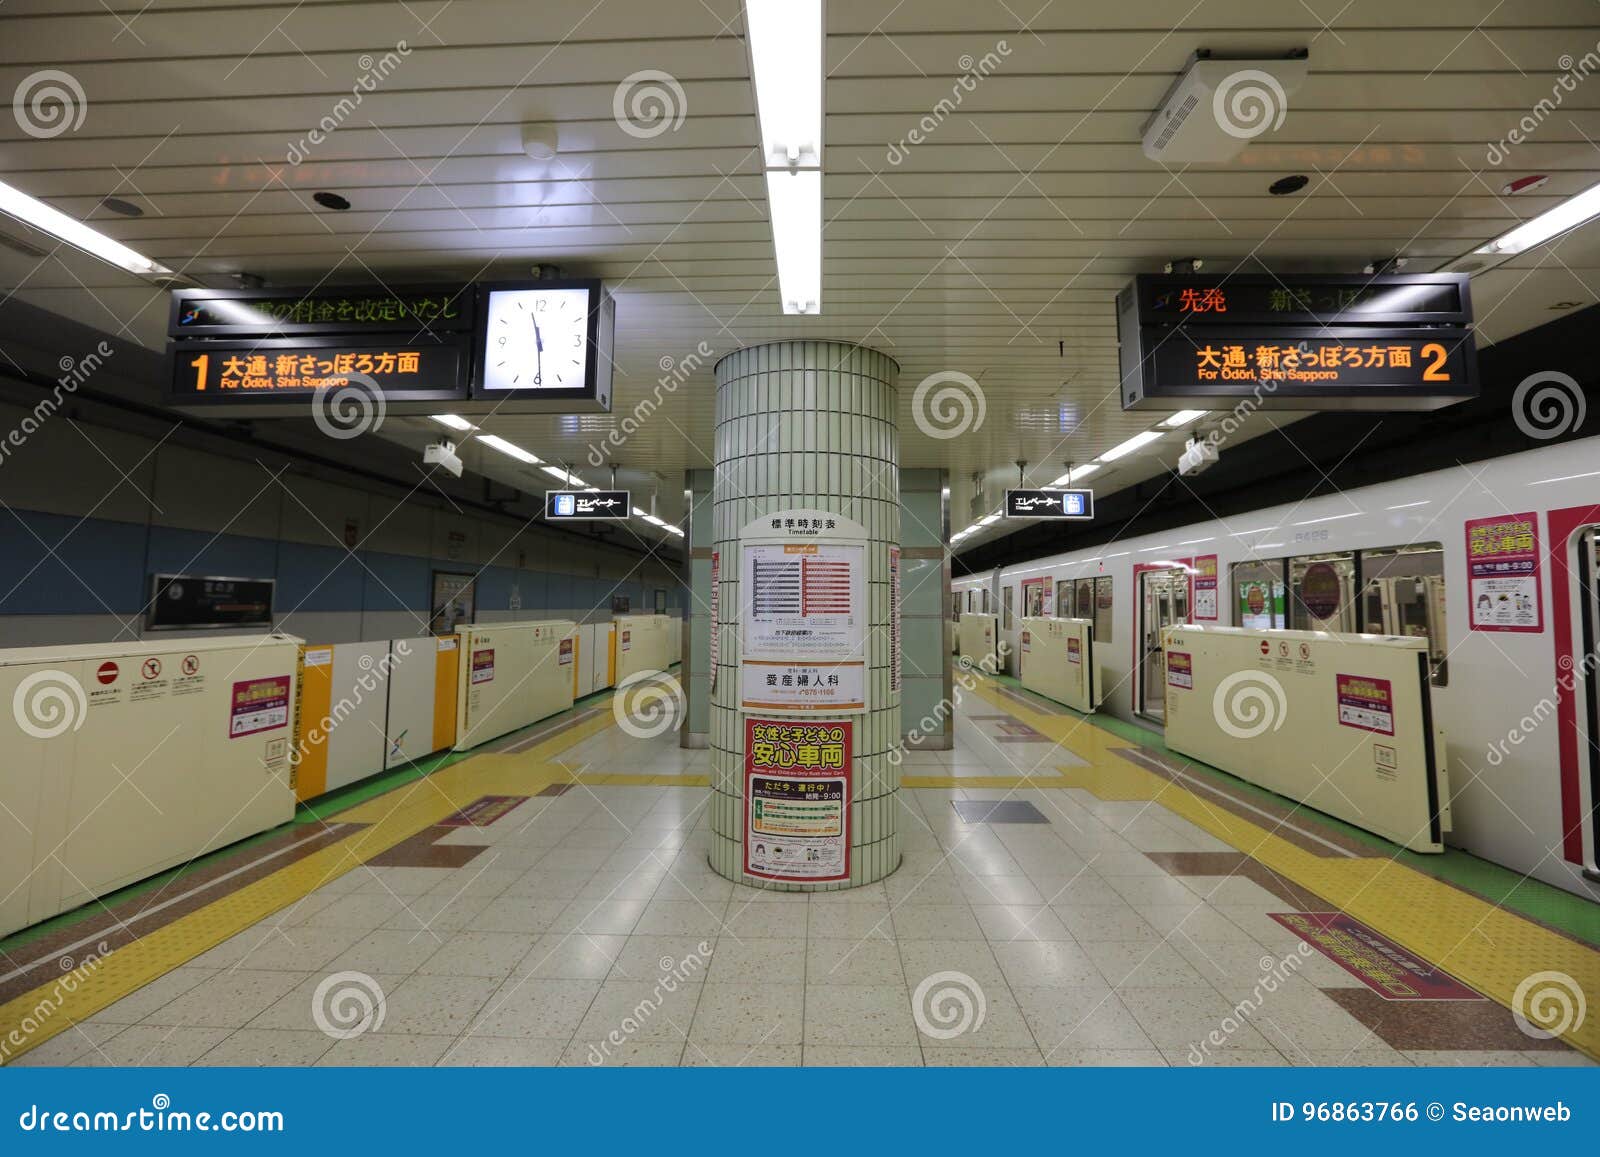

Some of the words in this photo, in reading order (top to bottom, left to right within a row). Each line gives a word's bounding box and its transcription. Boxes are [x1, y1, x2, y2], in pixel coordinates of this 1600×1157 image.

[536, 299, 547, 312] 12
[1179, 288, 1227, 313] 先発
[498, 336, 507, 348] 9
[573, 334, 582, 347] 3
[1420, 343, 1450, 381] 2
[191, 354, 209, 391] 1
[533, 372, 542, 385] 6
[1198, 369, 1218, 380] For
[1260, 368, 1286, 380] Shin
[1288, 369, 1339, 382] Sapporo
[220, 377, 240, 388] For
[277, 375, 300, 387] Shin
[302, 376, 349, 388] Sapporo
[1015, 497, 1061, 507] エレベーター
[771, 518, 836, 529] 標準時刻表
[766, 674, 839, 687] 愛産婦人科
[753, 725, 844, 742] 女性と子どもの
[753, 742, 844, 769] 安心車両
